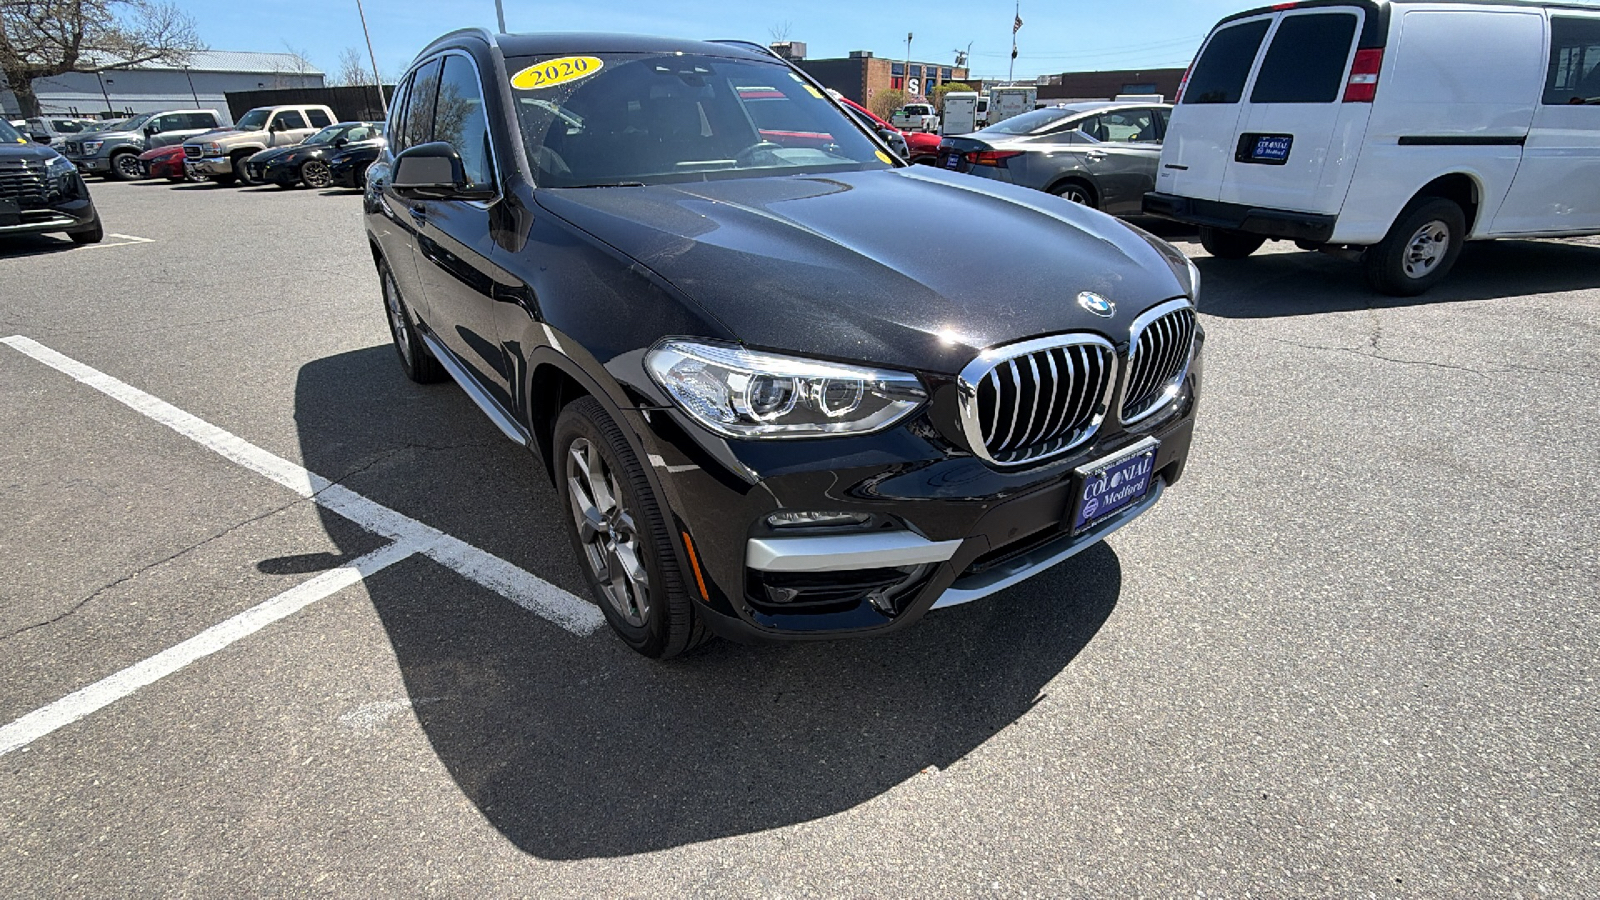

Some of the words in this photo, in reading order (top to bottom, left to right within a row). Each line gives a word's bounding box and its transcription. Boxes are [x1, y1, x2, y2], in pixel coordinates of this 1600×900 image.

[530, 58, 588, 86] 2020
[1083, 458, 1151, 501] COLONIAL
[1102, 478, 1144, 507] Medford
